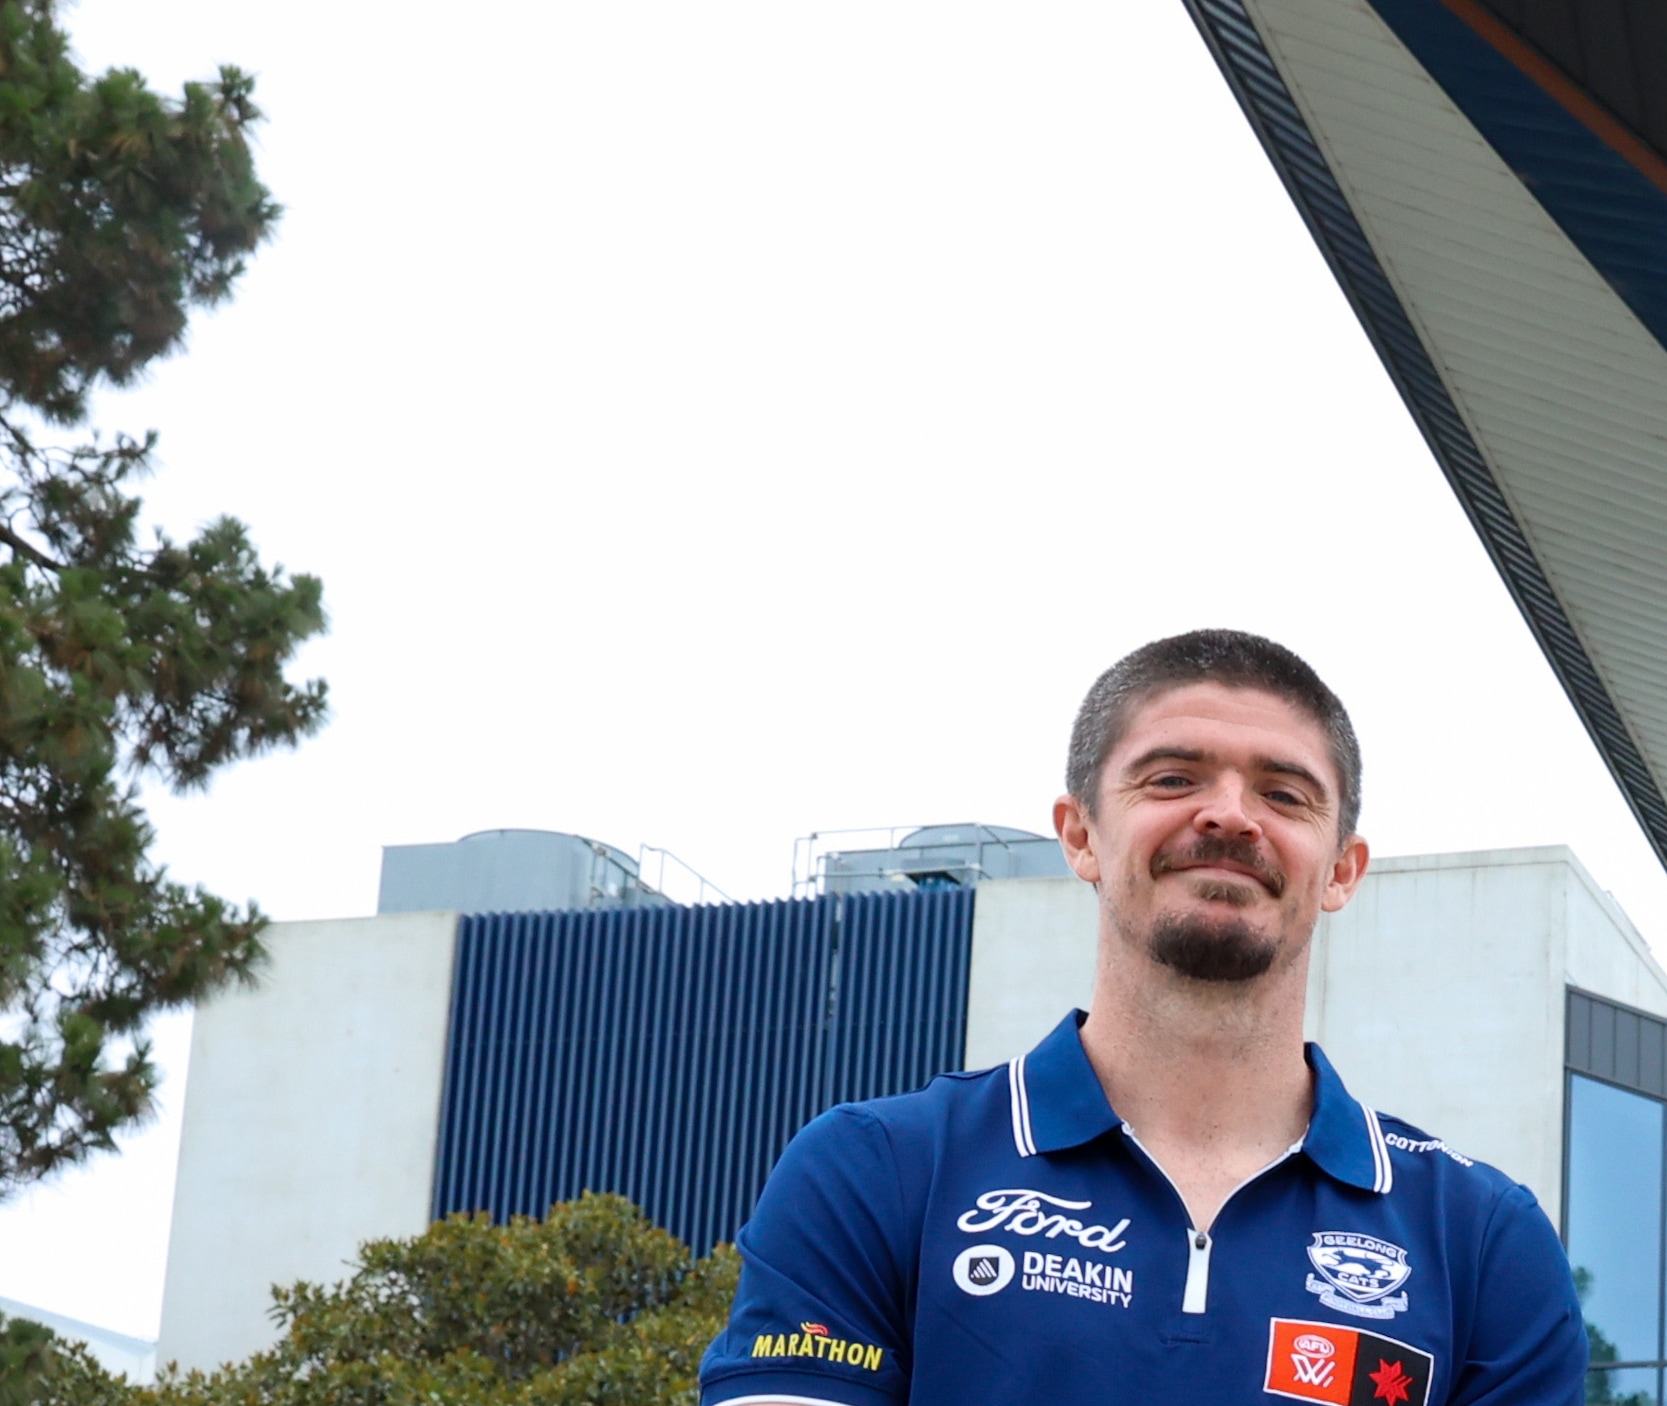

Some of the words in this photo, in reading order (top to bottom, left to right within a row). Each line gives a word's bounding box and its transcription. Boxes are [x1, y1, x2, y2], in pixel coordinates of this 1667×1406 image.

[957, 1189, 1130, 1252] Ford
[1323, 1236, 1397, 1258] GEELONG
[1023, 1251, 1133, 1293] DEAKIN
[1337, 1272, 1379, 1288] CATS
[1022, 1274, 1132, 1308] UNIVERSITY
[752, 1334, 883, 1371] MARATHON
[1298, 1340, 1330, 1353] AFL
